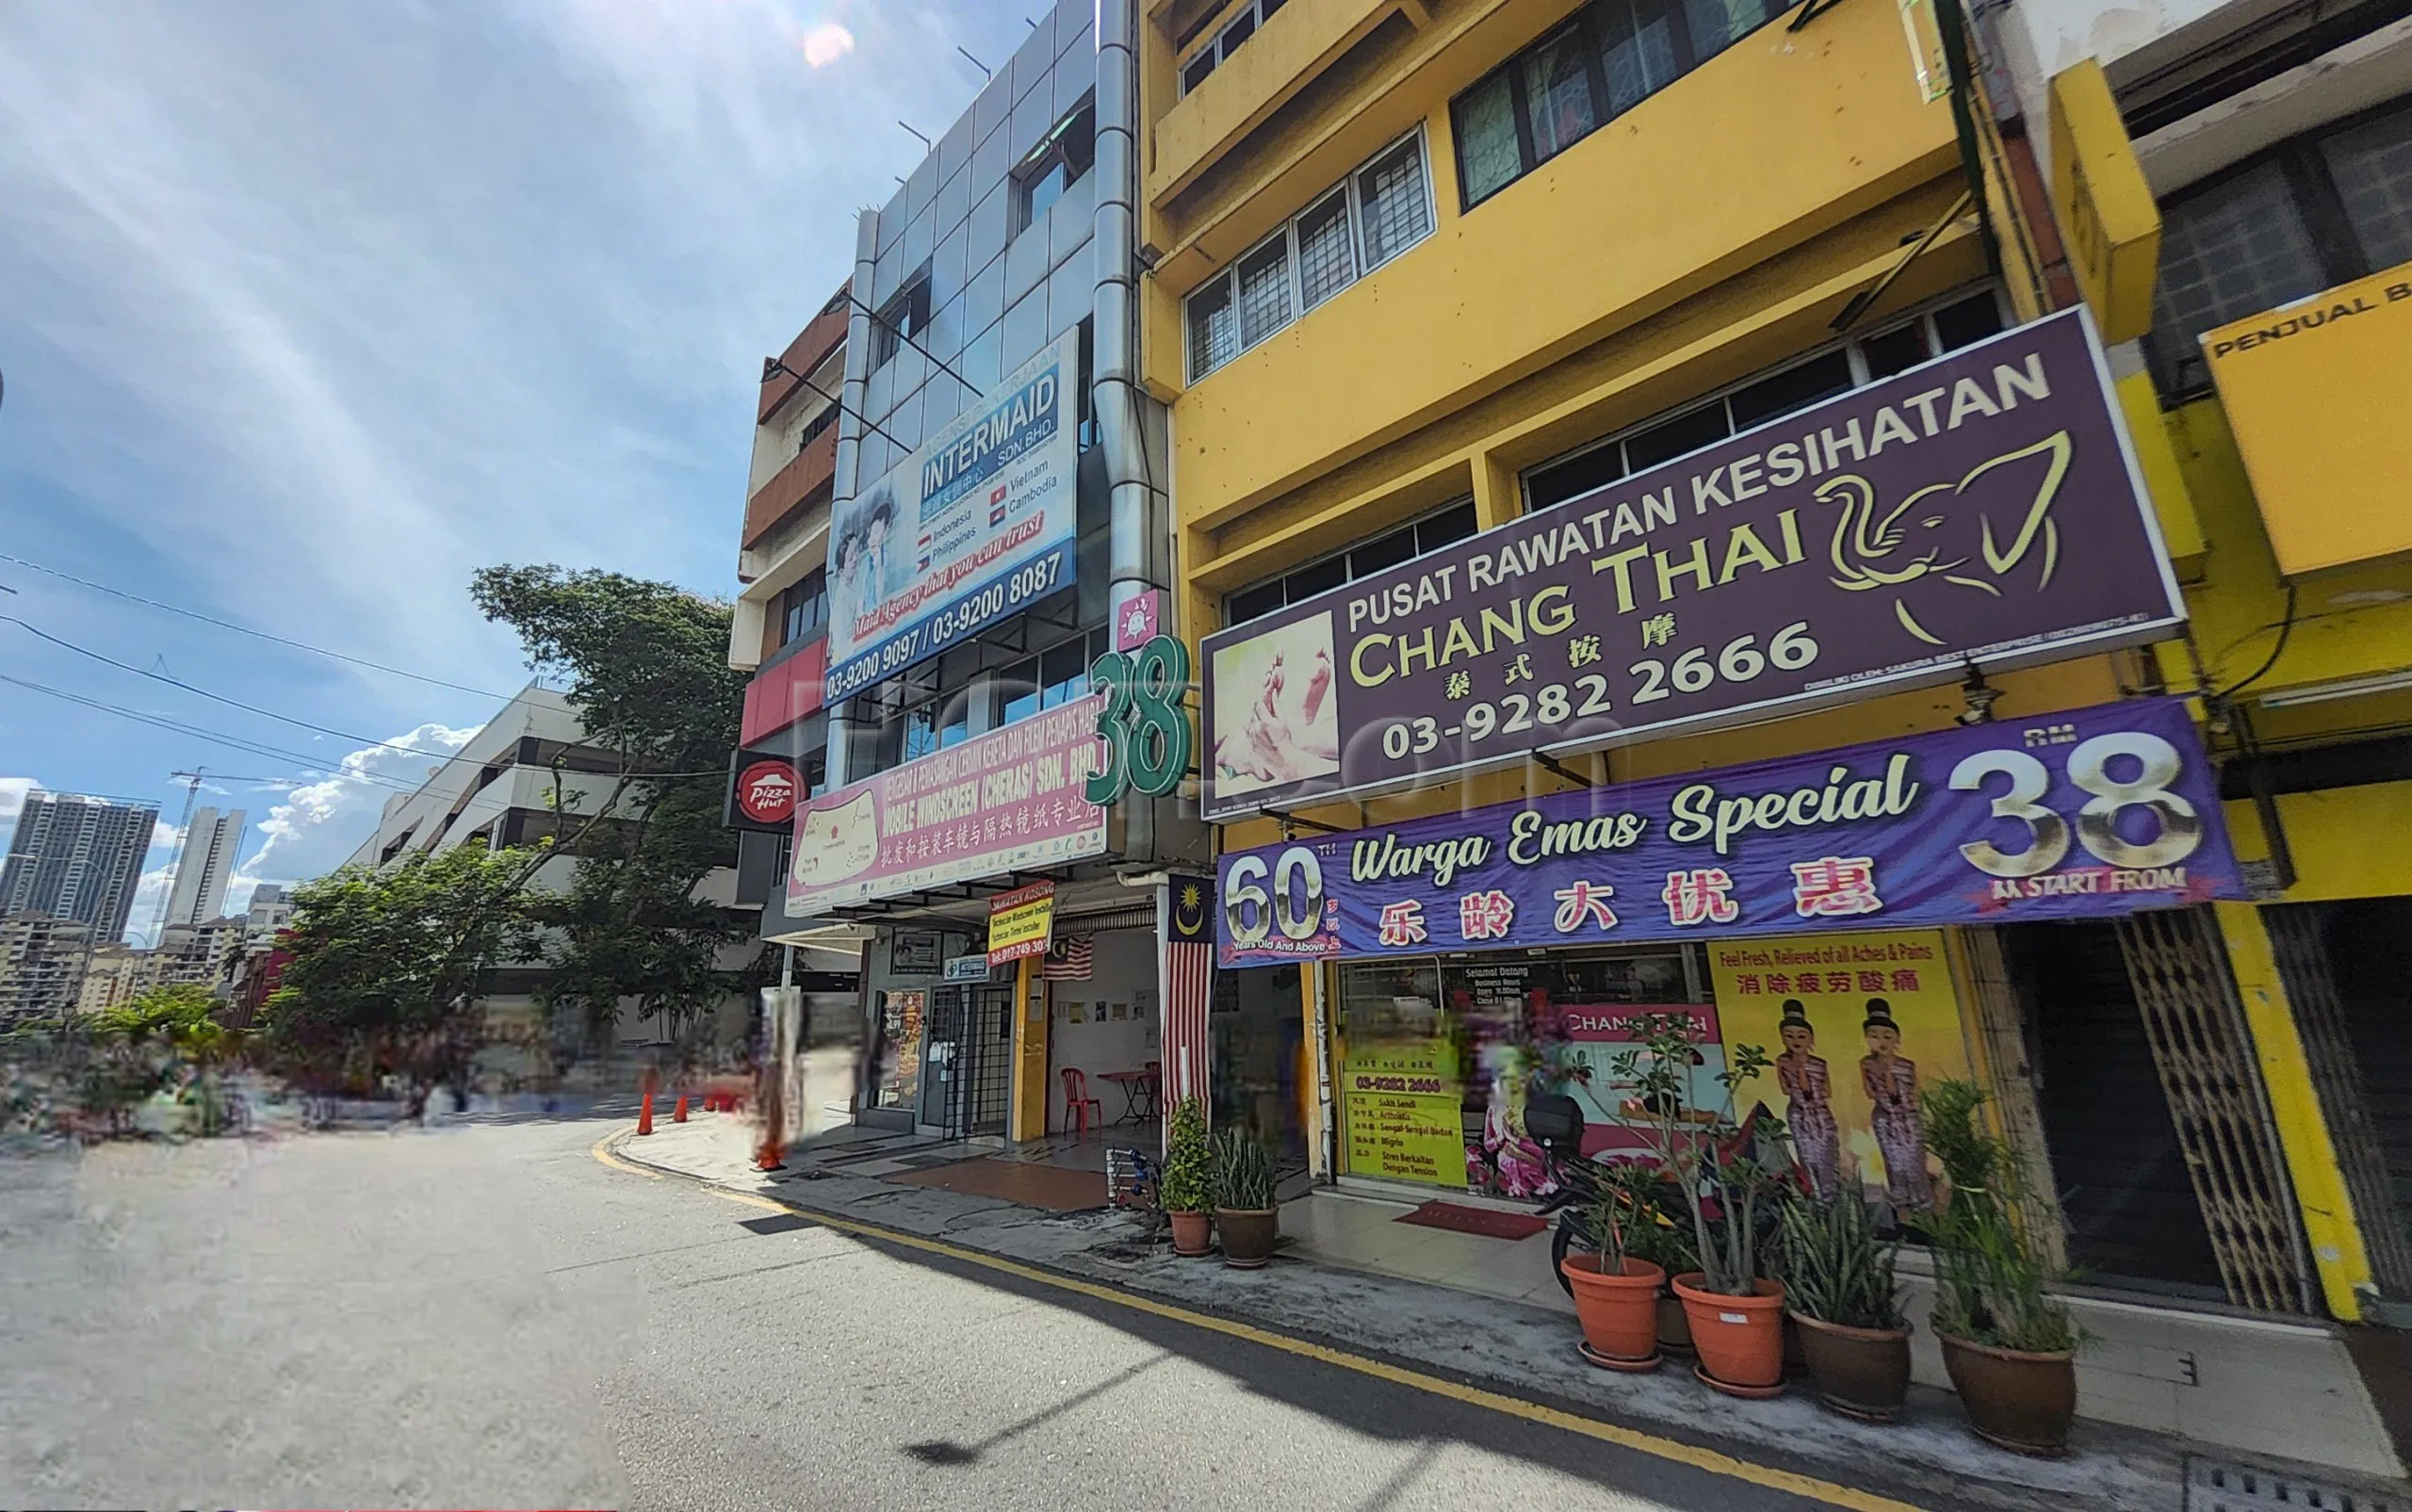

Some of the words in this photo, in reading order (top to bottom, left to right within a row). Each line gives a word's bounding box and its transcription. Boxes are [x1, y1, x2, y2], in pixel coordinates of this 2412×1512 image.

[2214, 298, 2379, 358] PENJUAL
[923, 374, 1054, 498] INTERMAID
[1010, 461, 1049, 492] Vietnam
[1348, 565, 1458, 633] PUSAT
[1469, 486, 1677, 593] RAWATAN
[1693, 353, 2051, 515] KESIHATAN
[1008, 476, 1057, 513] Cambodia
[933, 509, 971, 543] Indonesia
[932, 527, 976, 561] Philippines
[854, 610, 880, 636] Maid
[882, 586, 923, 624] Agency
[923, 570, 948, 597] that
[949, 559, 973, 586] you
[977, 538, 1002, 564] can
[1005, 513, 1043, 547] trust
[1349, 585, 1577, 689] CHANG
[1591, 507, 1806, 615] THAI
[827, 651, 878, 699] 03-9200
[882, 628, 920, 671] 9097
[933, 582, 1003, 644] 03-9200
[1009, 551, 1061, 604] 8087
[1443, 611, 1680, 702] 泰式按摩
[1382, 674, 1613, 760] 03-9282
[1630, 622, 1819, 705] 2666
[1007, 727, 1023, 762] DAN
[1023, 719, 1045, 759] FILEM
[1046, 707, 1077, 749] PENAPIS
[1079, 634, 1192, 806] 38
[2023, 723, 2077, 748] RM
[757, 798, 788, 810] Hut
[882, 801, 914, 838] MOBILE
[917, 779, 978, 829] WINDSCREEN
[981, 760, 1033, 812] (CHERAS)
[1036, 753, 1065, 795] SDN.
[1069, 741, 1100, 786] BHD.
[1948, 732, 2203, 877] 38
[1350, 834, 1492, 886] Warga
[1508, 811, 1647, 865] Emas
[1669, 755, 1918, 853] Special
[1225, 847, 1324, 945] 60
[1317, 842, 1337, 856] TH
[1379, 856, 1883, 946] 乐龄大优惠
[2026, 872, 2104, 900] START
[2110, 867, 2187, 893] FROM
[1002, 943, 1030, 960] 017-749
[1233, 941, 1256, 951] Years
[1258, 938, 1274, 950] Old
[1275, 941, 1294, 951] And
[1296, 942, 1326, 952] Above
[1719, 951, 1742, 967] Feel
[1742, 949, 1774, 967] Fresh,
[1774, 947, 1821, 966] Relieved
[1822, 946, 1836, 964] of
[1837, 945, 1850, 962] all
[1852, 943, 1886, 961] Aches
[1887, 943, 1898, 961] &
[1899, 942, 1933, 960] Pains
[1466, 967, 1497, 977] Selamat
[1499, 967, 1529, 977] Datang
[1736, 968, 1919, 995] 消除疲劳酸痛
[1356, 1076, 1407, 1092] 03-9282
[1408, 1078, 1442, 1093] 2666
[1396, 1099, 1416, 1109] Sendi
[1380, 1123, 1429, 1136] Sengal-Sengal
[1430, 1127, 1453, 1137] Badan
[1382, 1151, 1399, 1162] Stres
[1400, 1153, 1435, 1165] Berkaitan
[1382, 1162, 1410, 1174] Dengan
[1410, 1165, 1439, 1177] Tension
